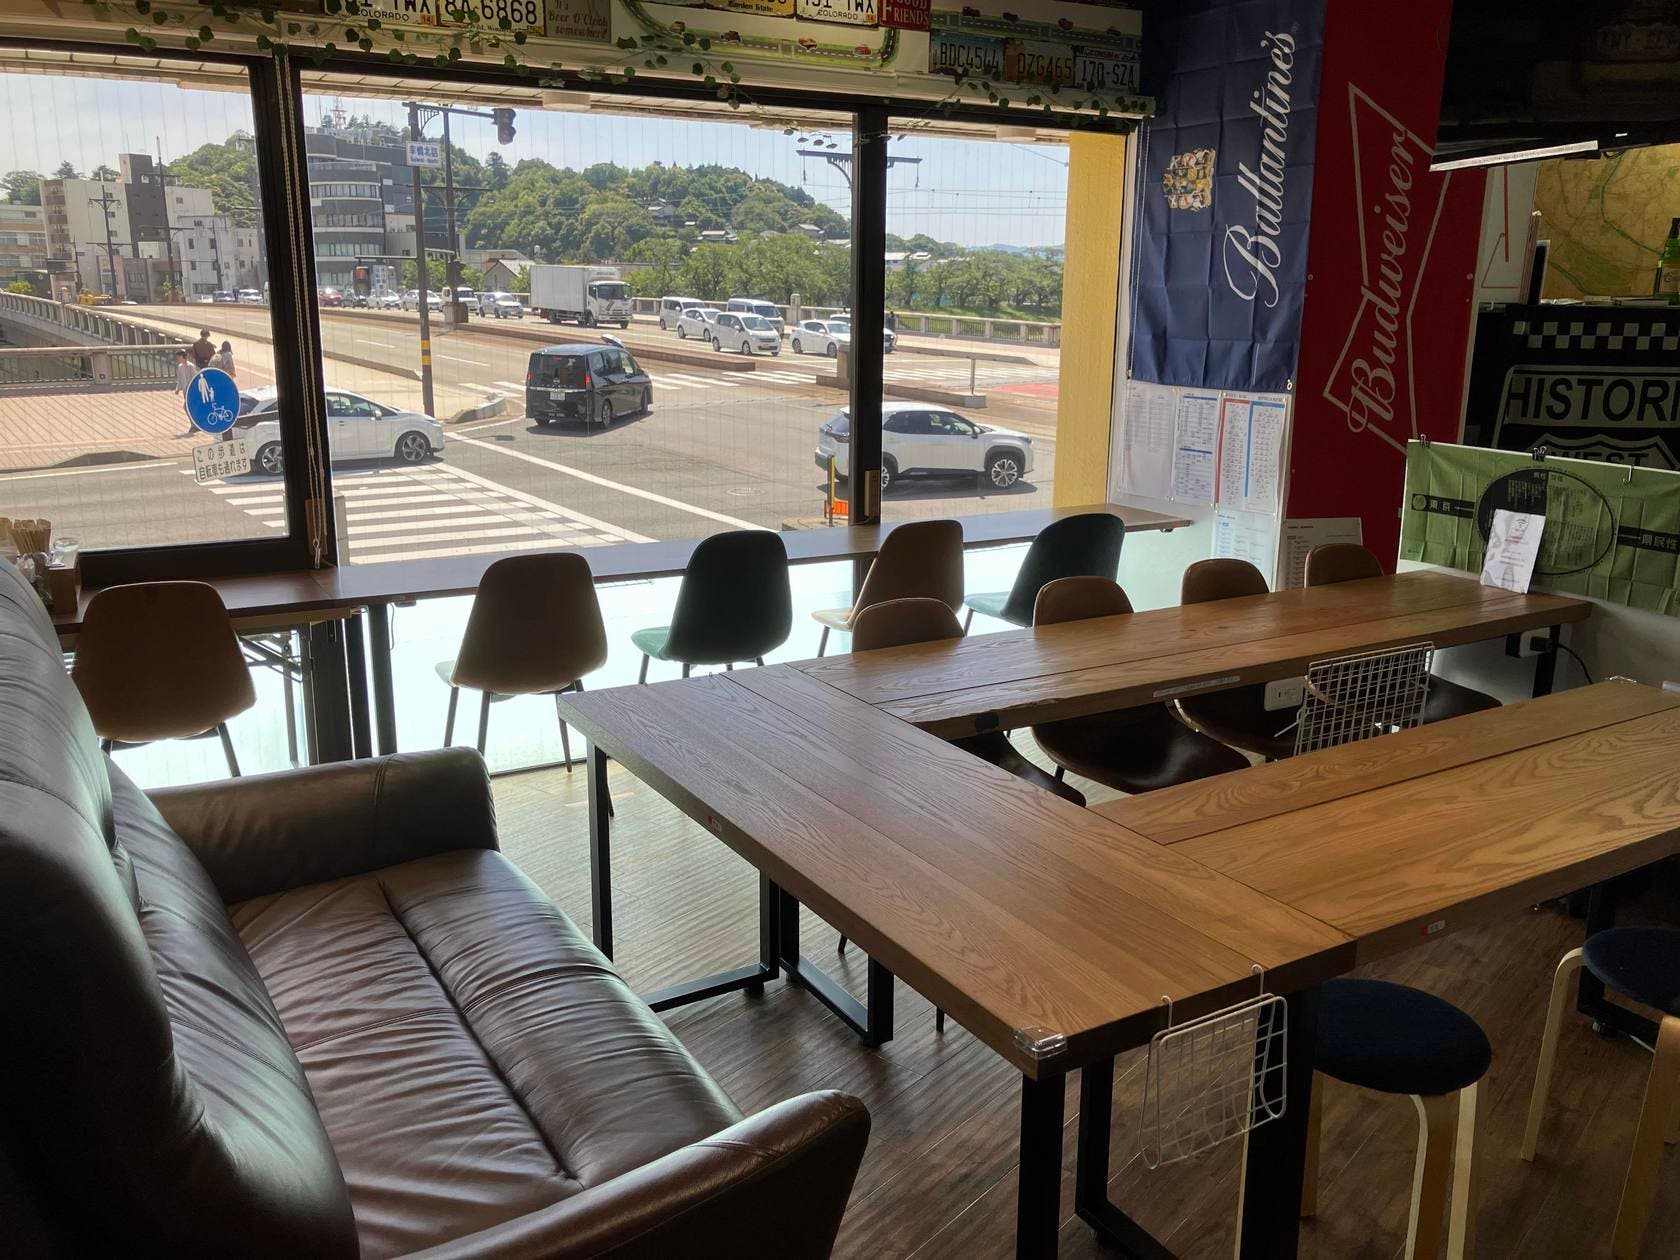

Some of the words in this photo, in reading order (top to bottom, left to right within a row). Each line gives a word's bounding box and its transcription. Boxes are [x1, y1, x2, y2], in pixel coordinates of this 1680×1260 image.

[357, 9, 409, 21] OLORADO
[818, 9, 858, 20] COLORADO
[882, 0, 928, 25] FRIENDS
[1222, 30, 1297, 308] Ballantine's
[1348, 125, 1418, 433] Budweiser
